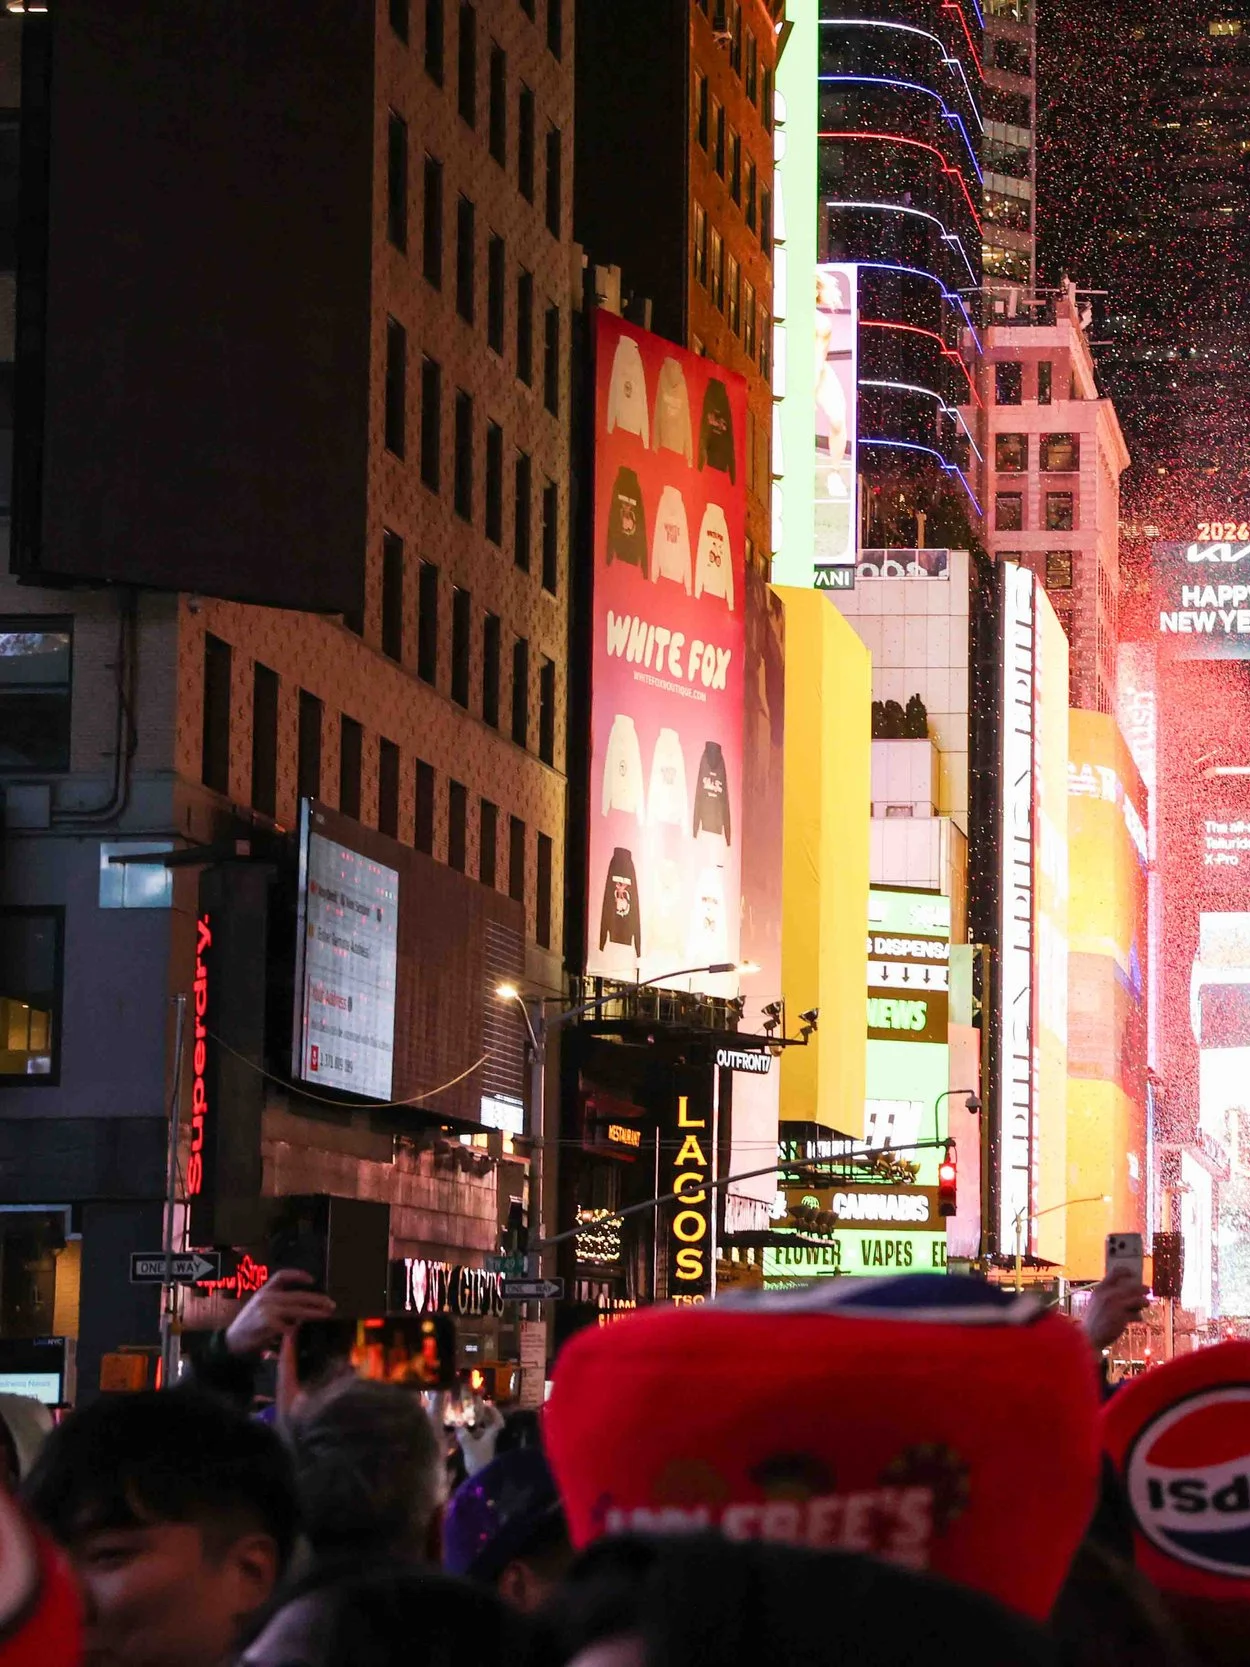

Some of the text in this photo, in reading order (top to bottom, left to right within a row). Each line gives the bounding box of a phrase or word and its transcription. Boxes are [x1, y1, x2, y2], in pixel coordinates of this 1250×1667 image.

[1197, 522, 1250, 541] 2026
[1159, 611, 1216, 633] NEW
[607, 610, 731, 690] WHITE FOX
[832, 1192, 930, 1222] CANNABIS
[140, 1259, 201, 1273] ONE WAY
[861, 1239, 913, 1267] VAPES
[427, 1259, 453, 1313] NY
[457, 1265, 506, 1318] GIFTS
